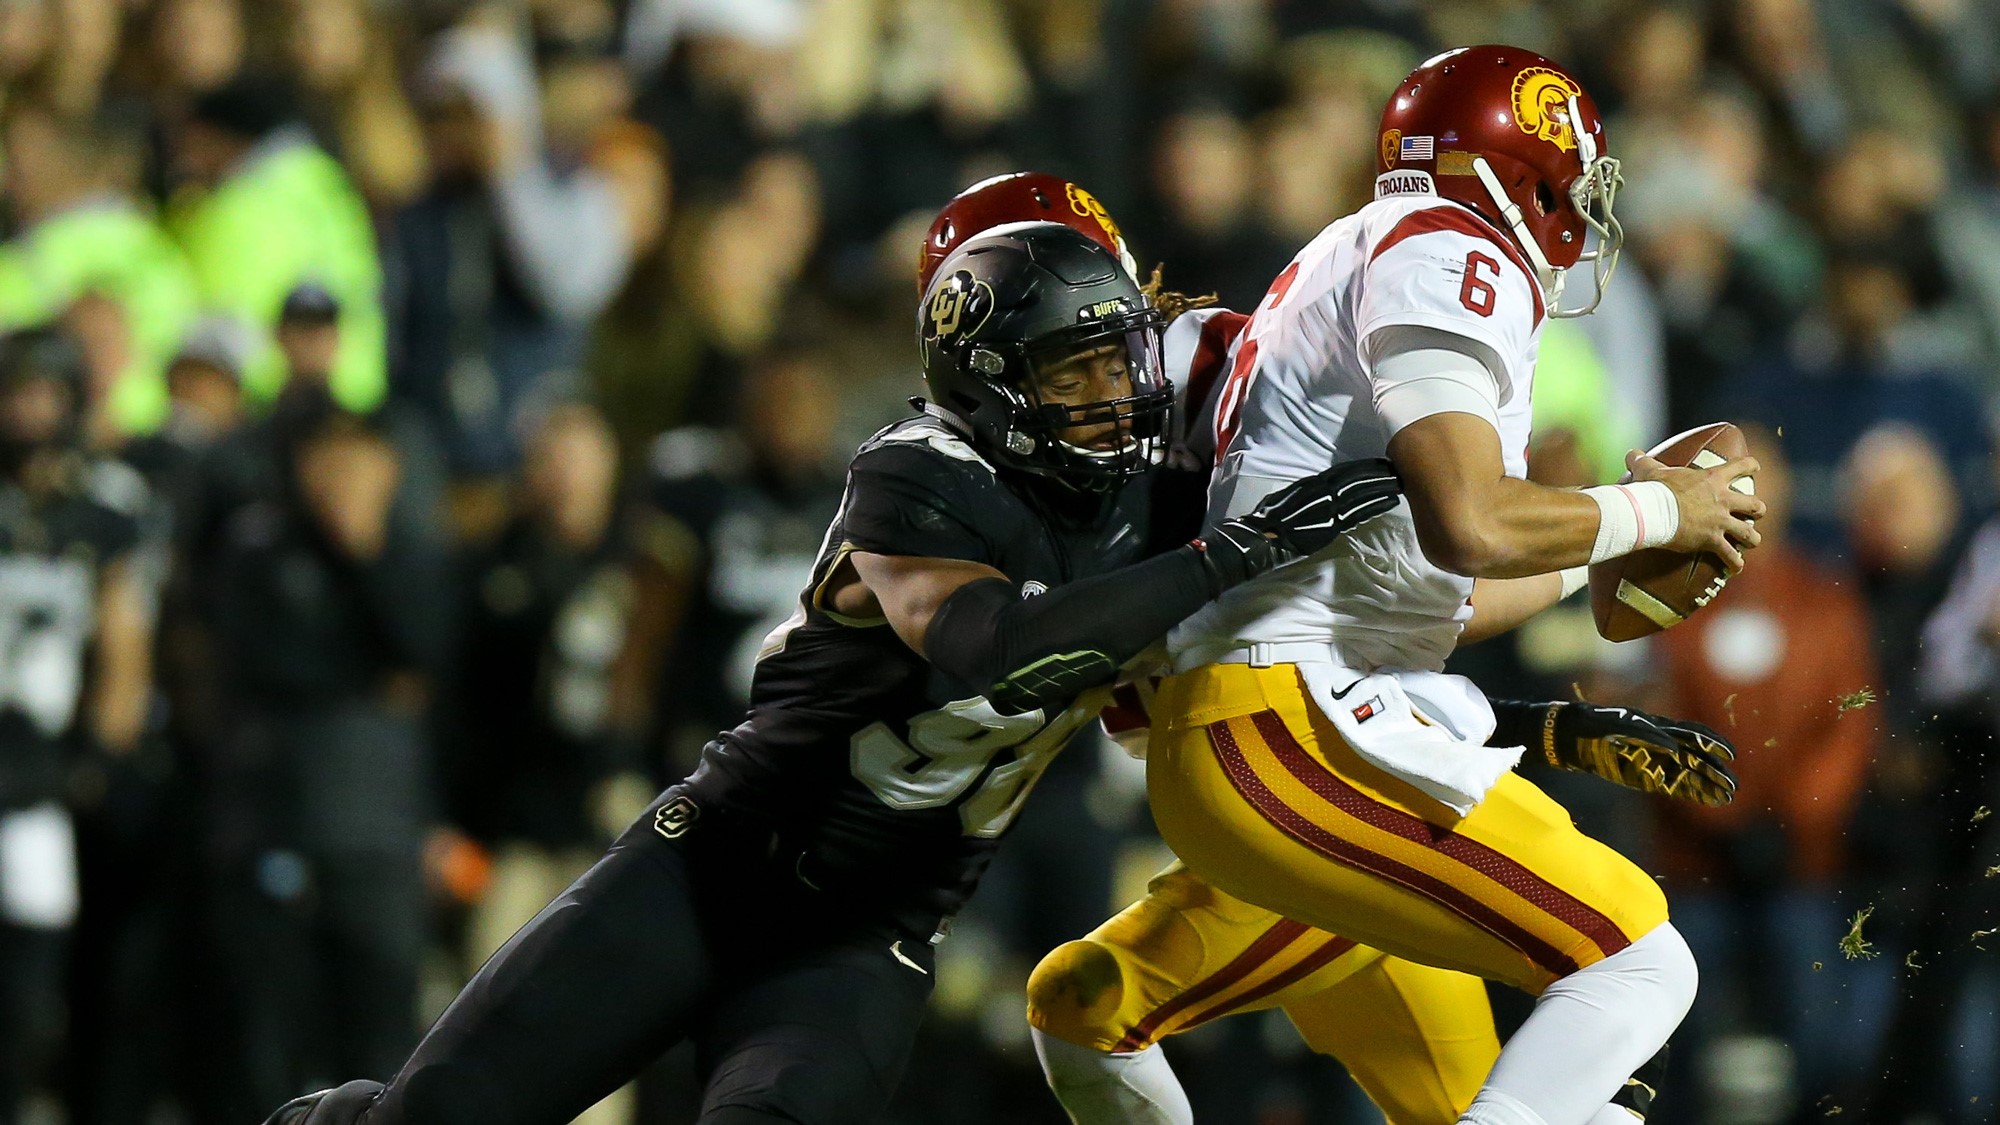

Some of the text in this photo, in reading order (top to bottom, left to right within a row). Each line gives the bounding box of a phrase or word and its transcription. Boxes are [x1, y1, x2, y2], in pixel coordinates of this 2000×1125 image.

[1377, 176, 1430, 197] TROJANS
[1459, 250, 1500, 318] 6
[1543, 706, 1559, 766] COMMON
